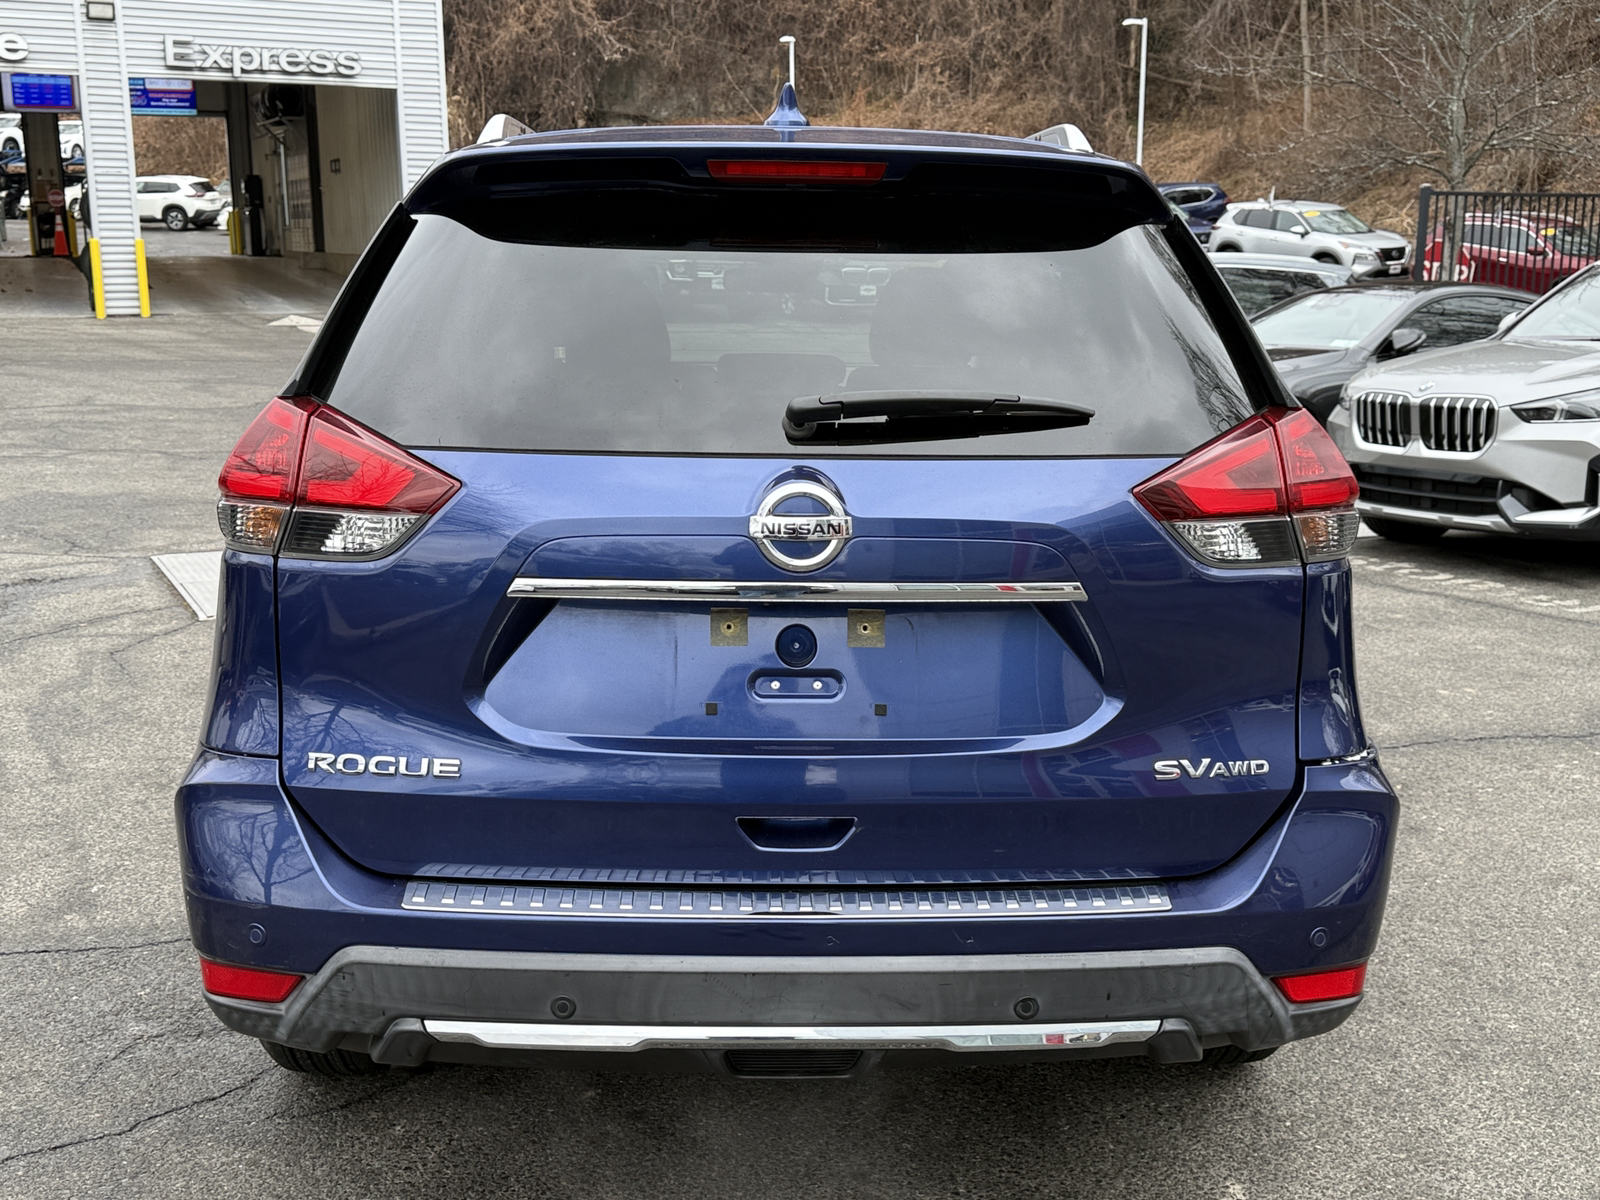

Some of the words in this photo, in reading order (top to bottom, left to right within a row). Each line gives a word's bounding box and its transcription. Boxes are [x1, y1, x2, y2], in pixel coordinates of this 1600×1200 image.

[164, 34, 362, 77] Express
[760, 522, 842, 536] NISSAN
[307, 752, 461, 779] ROGUE
